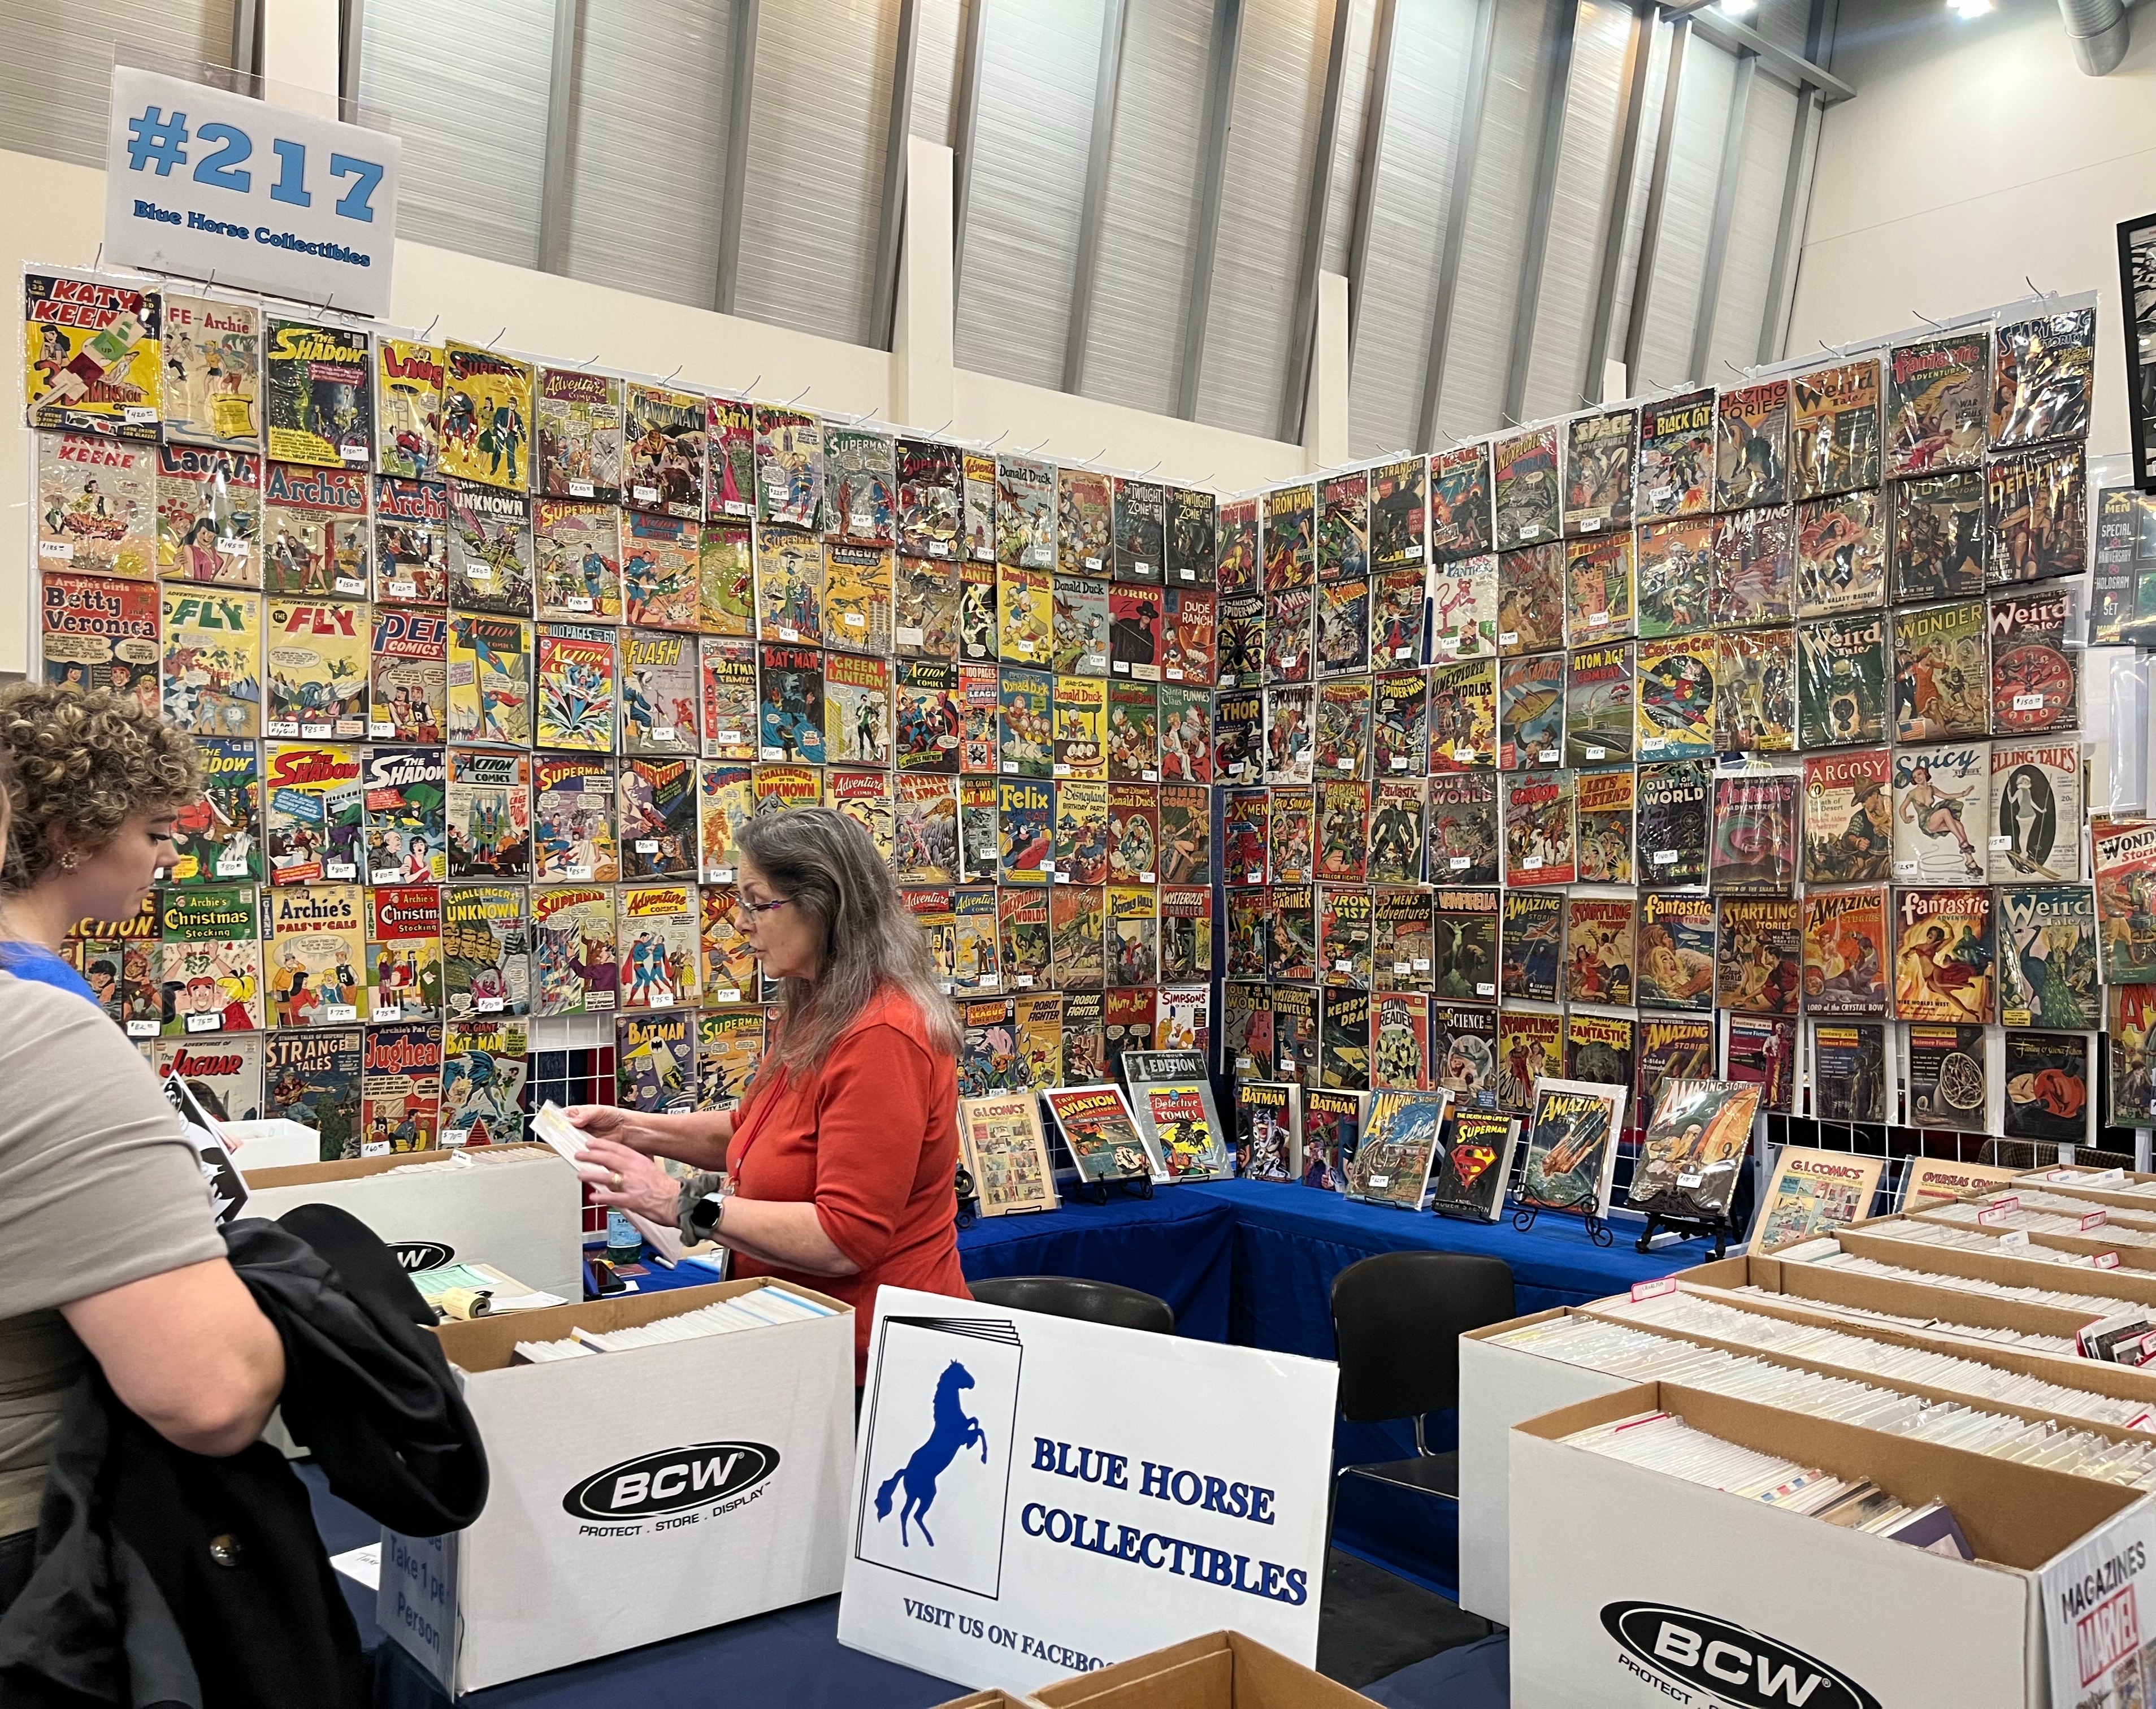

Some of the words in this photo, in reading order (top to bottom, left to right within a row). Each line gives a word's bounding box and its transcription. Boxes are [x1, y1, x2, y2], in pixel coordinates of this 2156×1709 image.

[128, 106, 383, 223] #217
[133, 199, 182, 225] Blue
[188, 212, 249, 240] Horse
[254, 227, 370, 267] Collectibles
[50, 279, 138, 311] KATY
[32, 300, 119, 329] KEEN
[205, 313, 249, 333] Archie
[268, 328, 366, 362] SHADOW
[384, 347, 443, 389] Laug
[545, 375, 605, 397] Adventure
[634, 396, 700, 429] HAWKMAN
[1657, 411, 1690, 436] BLACK
[58, 446, 135, 470] KEENE
[831, 439, 888, 459] SUPERMAN
[159, 446, 254, 484] Laugh
[1000, 465, 1027, 480] Donald
[1030, 470, 1052, 484] Duck
[266, 467, 362, 508] Archie
[1129, 483, 1162, 502] TWILIGHT
[453, 492, 524, 516] UNKNOWN
[1183, 489, 1212, 509] TWILIGHT
[1272, 497, 1291, 515] IRON
[1294, 493, 1313, 510] MAN
[2105, 503, 2130, 514] MEN
[541, 504, 608, 527] SUPERMAN
[2102, 523, 2131, 537] SPECIAL
[835, 549, 879, 558] LEAGUE
[1054, 578, 1080, 592] Donald
[1082, 581, 1104, 595] Duck
[1109, 587, 1158, 601] ZORRO
[45, 587, 121, 617] Betty
[1185, 601, 1210, 614] DUDE
[2103, 602, 2118, 615] SET
[44, 609, 155, 637] Veronica
[170, 600, 245, 632] FLY
[285, 607, 357, 638] FLY
[1183, 612, 1213, 626] RANCH
[1897, 604, 1984, 641] WONDER
[1990, 596, 2073, 635] Weird
[565, 627, 592, 641] PAGES
[388, 641, 440, 656] COMICS
[628, 637, 683, 665] FLASH
[834, 656, 878, 674] GREEN
[829, 668, 883, 687] LANTERN
[1054, 689, 1078, 701] Donald
[1081, 690, 1103, 702] Duck
[1382, 679, 1426, 699] SPIDER-MAN
[1452, 680, 1493, 698] WORLDS
[1222, 700, 1259, 721] THOR
[267, 751, 359, 787] SHADOW
[309, 755, 333, 764] THE
[402, 758, 425, 766] THE
[2036, 748, 2075, 773] TALES
[475, 773, 510, 783] COMICS
[540, 763, 606, 790] SUPERMAN
[1810, 759, 1886, 782] ARGOSY
[758, 783, 814, 797] UNKNOWN
[835, 778, 883, 797] Adventure
[917, 786, 951, 801] SPACE
[1646, 779, 1673, 791] OUT
[1000, 784, 1048, 812] Felix
[1109, 795, 1134, 806] Donald
[1135, 796, 1156, 808] Duck
[1162, 796, 1203, 808] COMICS
[1644, 787, 1703, 805] WORLD
[1025, 811, 1048, 821] CAT
[2099, 829, 2156, 860] WOND
[190, 897, 227, 907] Archie's
[404, 894, 434, 904] Archie's
[533, 893, 605, 920] SUPERMAN
[628, 891, 686, 915] Adventure
[1162, 892, 1204, 905] MYSTERIOUS
[1333, 895, 1370, 907] IRON
[1505, 897, 1559, 920] AMAZING
[164, 907, 249, 930] Christmas
[280, 899, 352, 919] Archie's
[446, 903, 519, 921] UNKNOWN
[1165, 905, 1204, 917] TRAVELER
[1335, 906, 1370, 919] FIST
[1375, 905, 1430, 921] Adventures
[1570, 904, 1631, 927] STARTLING
[1724, 903, 1797, 929] STARTLING
[1808, 895, 1881, 932] AMAZING
[186, 927, 230, 938] Stocking
[399, 923, 436, 932] Stocking
[1756, 921, 1790, 930] STORIES
[1073, 995, 1100, 1005] ROBOT
[1162, 993, 1206, 1005] SIMPSONS
[1230, 986, 1250, 995] OUT
[1033, 1000, 1060, 1010] ROBOT
[1067, 1005, 1100, 1016] FIGHTER
[1226, 996, 1270, 1010] WORLD
[1028, 1010, 1060, 1022] FIGHTER
[1447, 1008, 1484, 1029] SCIENCE
[628, 1021, 685, 1045] BATMAN
[1500, 1018, 1559, 1039] STARTLING
[1570, 1025, 1628, 1042] FANTASTIC
[1644, 1025, 1709, 1055] AMAZING
[1675, 1042, 1710, 1051] STORIES
[160, 1049, 242, 1077] JAGUAR
[266, 1040, 345, 1068] STRANGE
[297, 1056, 332, 1072] TALES
[1150, 1057, 1196, 1073] EDITION
[1155, 1098, 1198, 1109] Detective
[1242, 1087, 1285, 1106] BATMAN
[1310, 1094, 1356, 1115] BATMAN
[1059, 1096, 1116, 1119] AVIATION
[1457, 1125, 1507, 1143] SUPERMAN
[1922, 1172, 1969, 1187] OVERSEAS
[1972, 1177, 2005, 1187] COMI
[610, 1454, 739, 1509] BCW
[1031, 1437, 1127, 1491] BLUE
[1139, 1461, 1276, 1525] HORSE
[579, 1524, 643, 1538] PROTECT
[655, 1514, 700, 1533] STORE
[390, 1534, 418, 1579] Take
[1021, 1503, 1308, 1606] COLLECTIBLES
[2062, 1541, 2146, 1624] MAGAZINES
[397, 1592, 440, 1654] Person
[903, 1597, 955, 1629] VISIT
[958, 1617, 984, 1637] US
[987, 1625, 1020, 1650] ON
[1021, 1634, 1116, 1672] FACEBO
[1654, 1621, 1823, 1708] BCW
[1617, 1653, 1692, 1706] PROTECT
